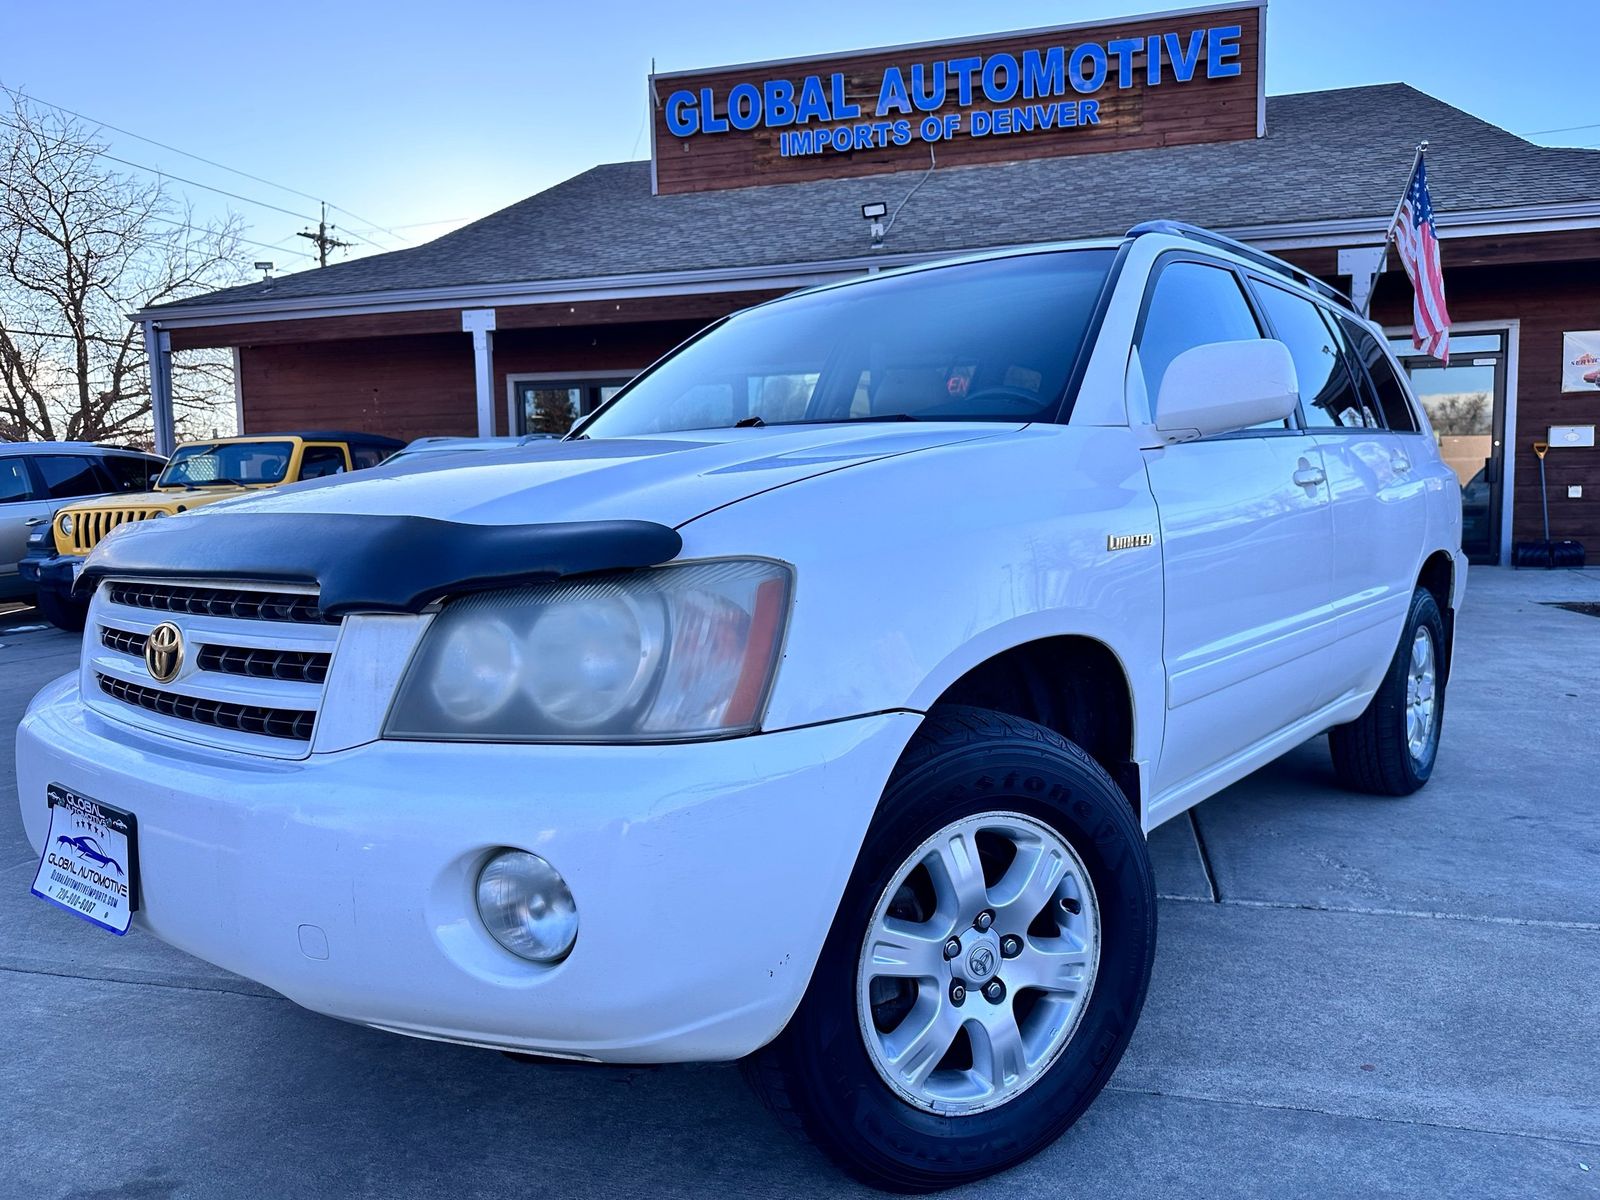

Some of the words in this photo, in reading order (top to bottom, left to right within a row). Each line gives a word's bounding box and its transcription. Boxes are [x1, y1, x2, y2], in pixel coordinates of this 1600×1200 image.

[665, 72, 860, 137] GLOBAL
[876, 25, 1242, 115] AUTOMOTIVE
[779, 121, 912, 157] IMPORTS
[920, 114, 960, 143] OF
[970, 100, 1100, 137] DENVER
[1107, 533, 1152, 551] LIMITED
[65, 803, 107, 825] AUTOMOTIVE
[66, 793, 105, 819] GLOBAL
[48, 853, 77, 875] GLOBAL
[77, 866, 127, 897] AUTOMOTIVE
